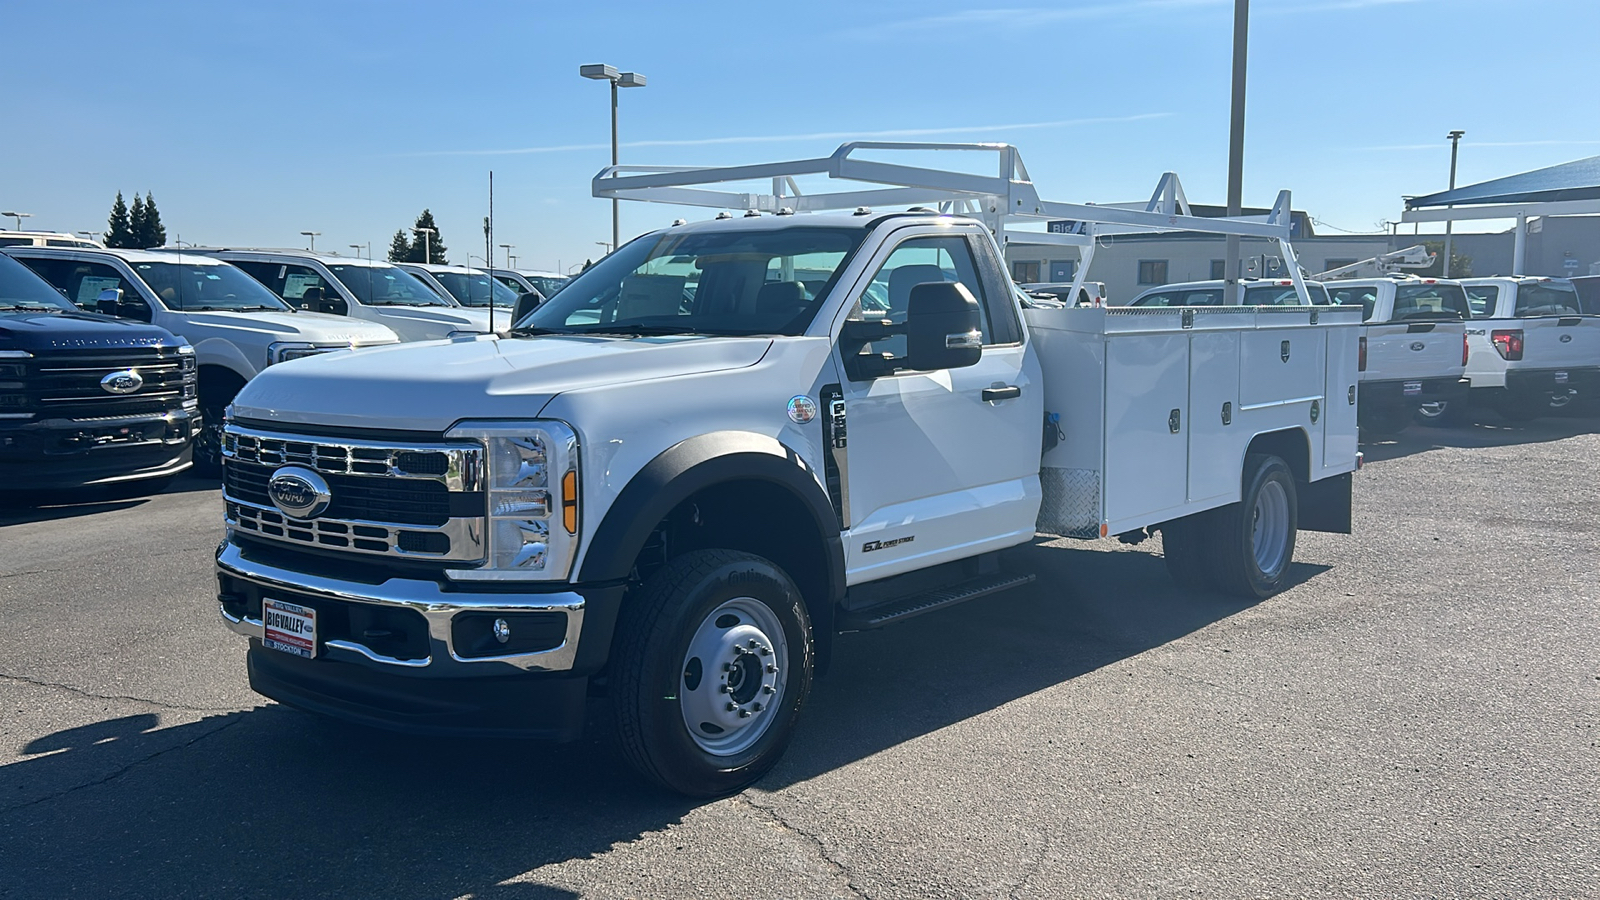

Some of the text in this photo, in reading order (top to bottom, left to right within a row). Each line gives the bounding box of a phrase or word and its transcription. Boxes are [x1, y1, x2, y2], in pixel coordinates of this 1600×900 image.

[1053, 223, 1072, 234] Big
[115, 377, 133, 387] Ford
[273, 481, 313, 503] Ford
[883, 539, 898, 547] POWER
[898, 535, 915, 544] STROKE
[273, 642, 302, 655] STOCKTON
